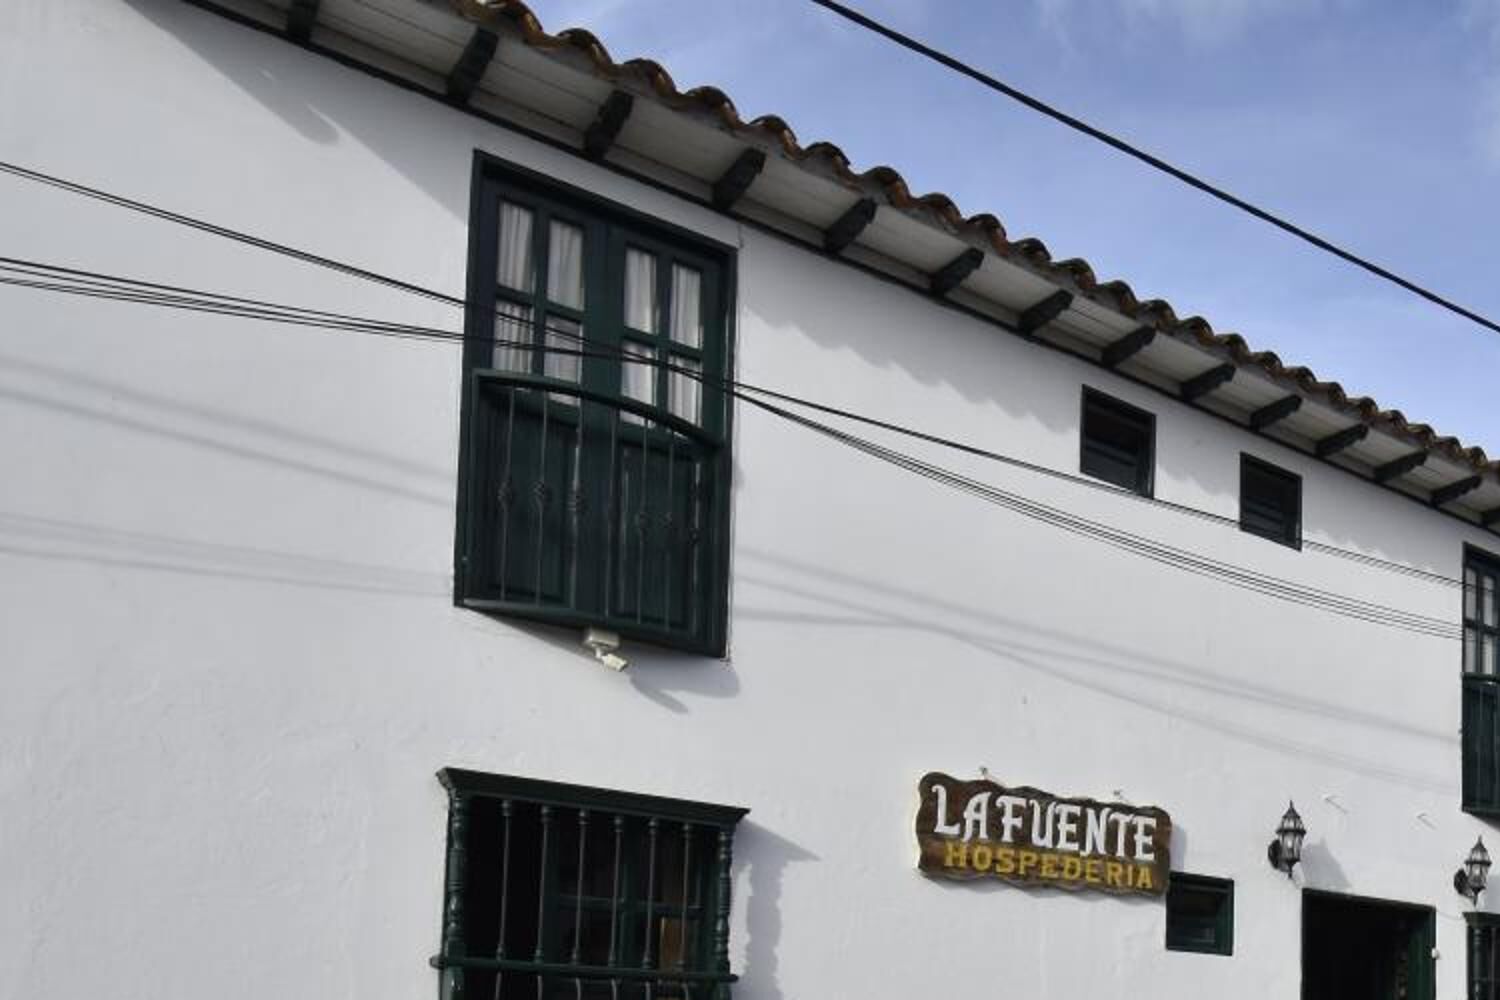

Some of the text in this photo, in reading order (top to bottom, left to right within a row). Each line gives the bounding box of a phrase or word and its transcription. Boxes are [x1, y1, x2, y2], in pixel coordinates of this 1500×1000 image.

[931, 784, 1156, 861] LA FUENTE
[944, 841, 1153, 889] HOSPEDERIA
